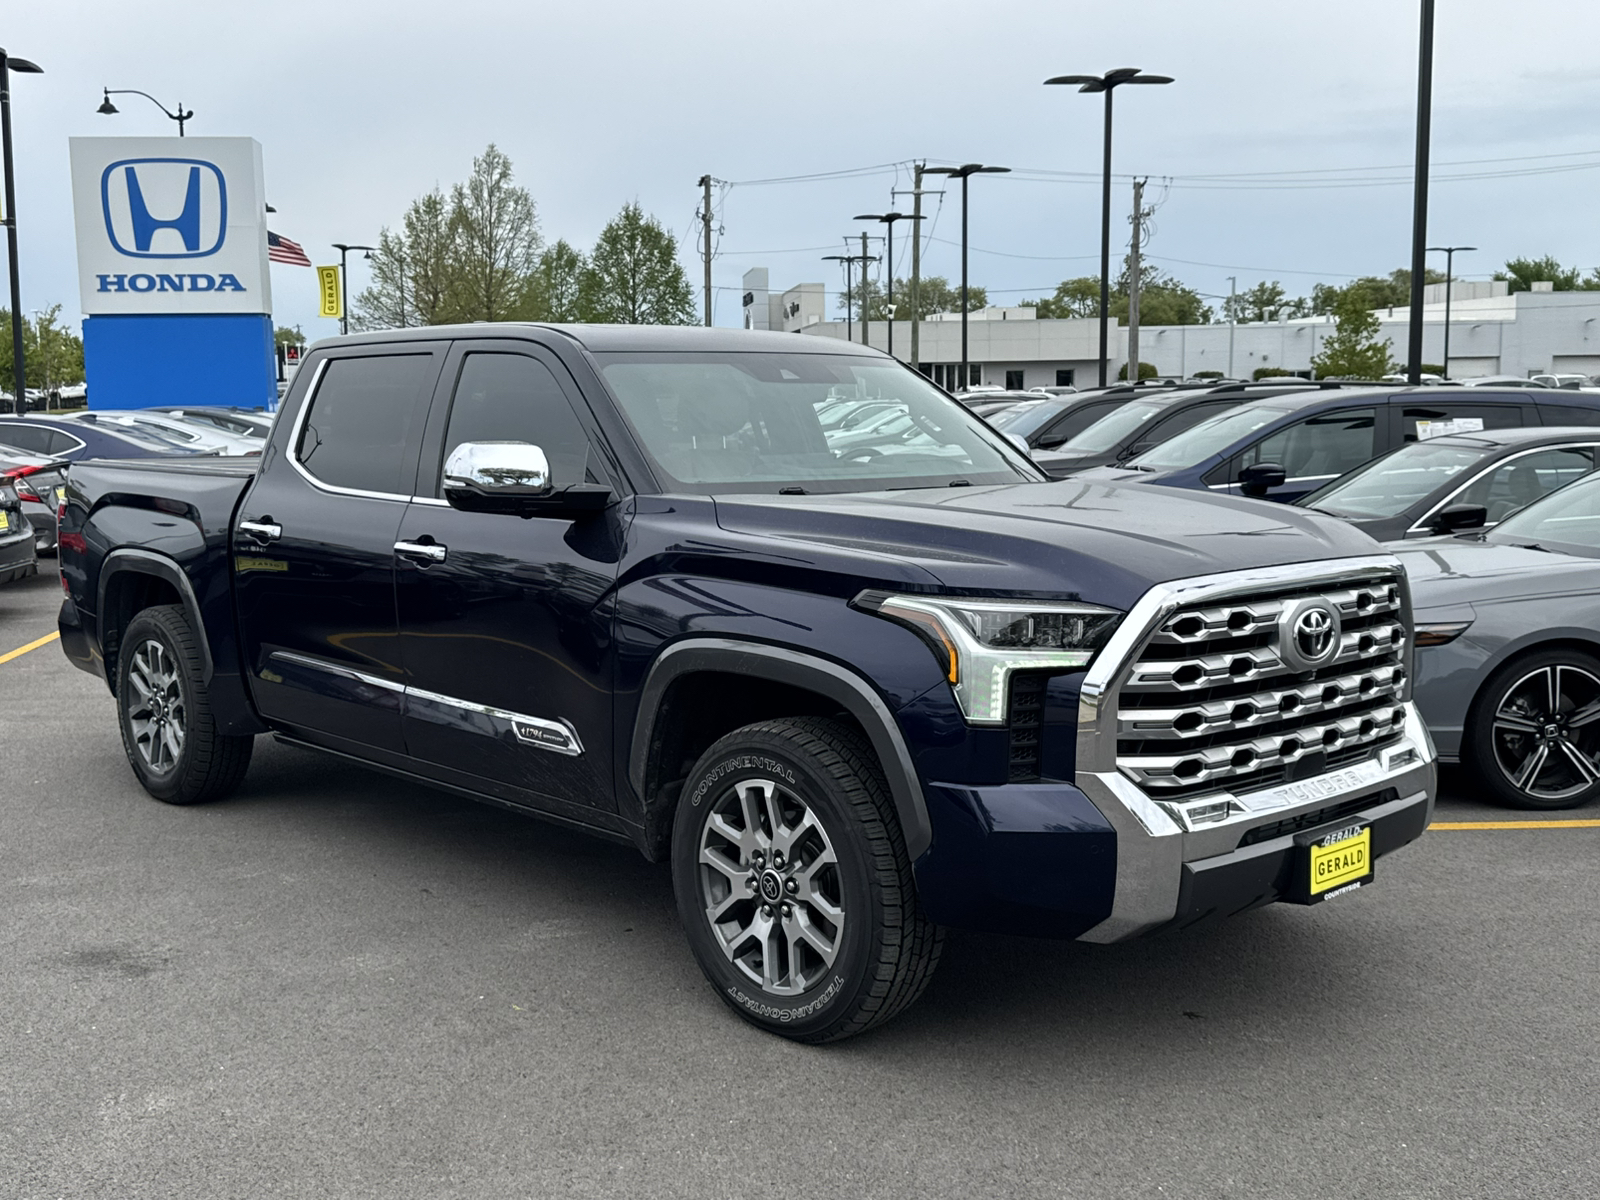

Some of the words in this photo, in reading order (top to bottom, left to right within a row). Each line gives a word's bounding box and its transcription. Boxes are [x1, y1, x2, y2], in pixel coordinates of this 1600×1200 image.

[96, 274, 247, 292] HONDA
[325, 272, 335, 311] GERALD
[692, 756, 796, 806] CONTINENTAL
[1273, 771, 1363, 804] TUNDRA
[1318, 850, 1363, 876] GERALD
[728, 975, 845, 1022] TERRAINCONTACT
